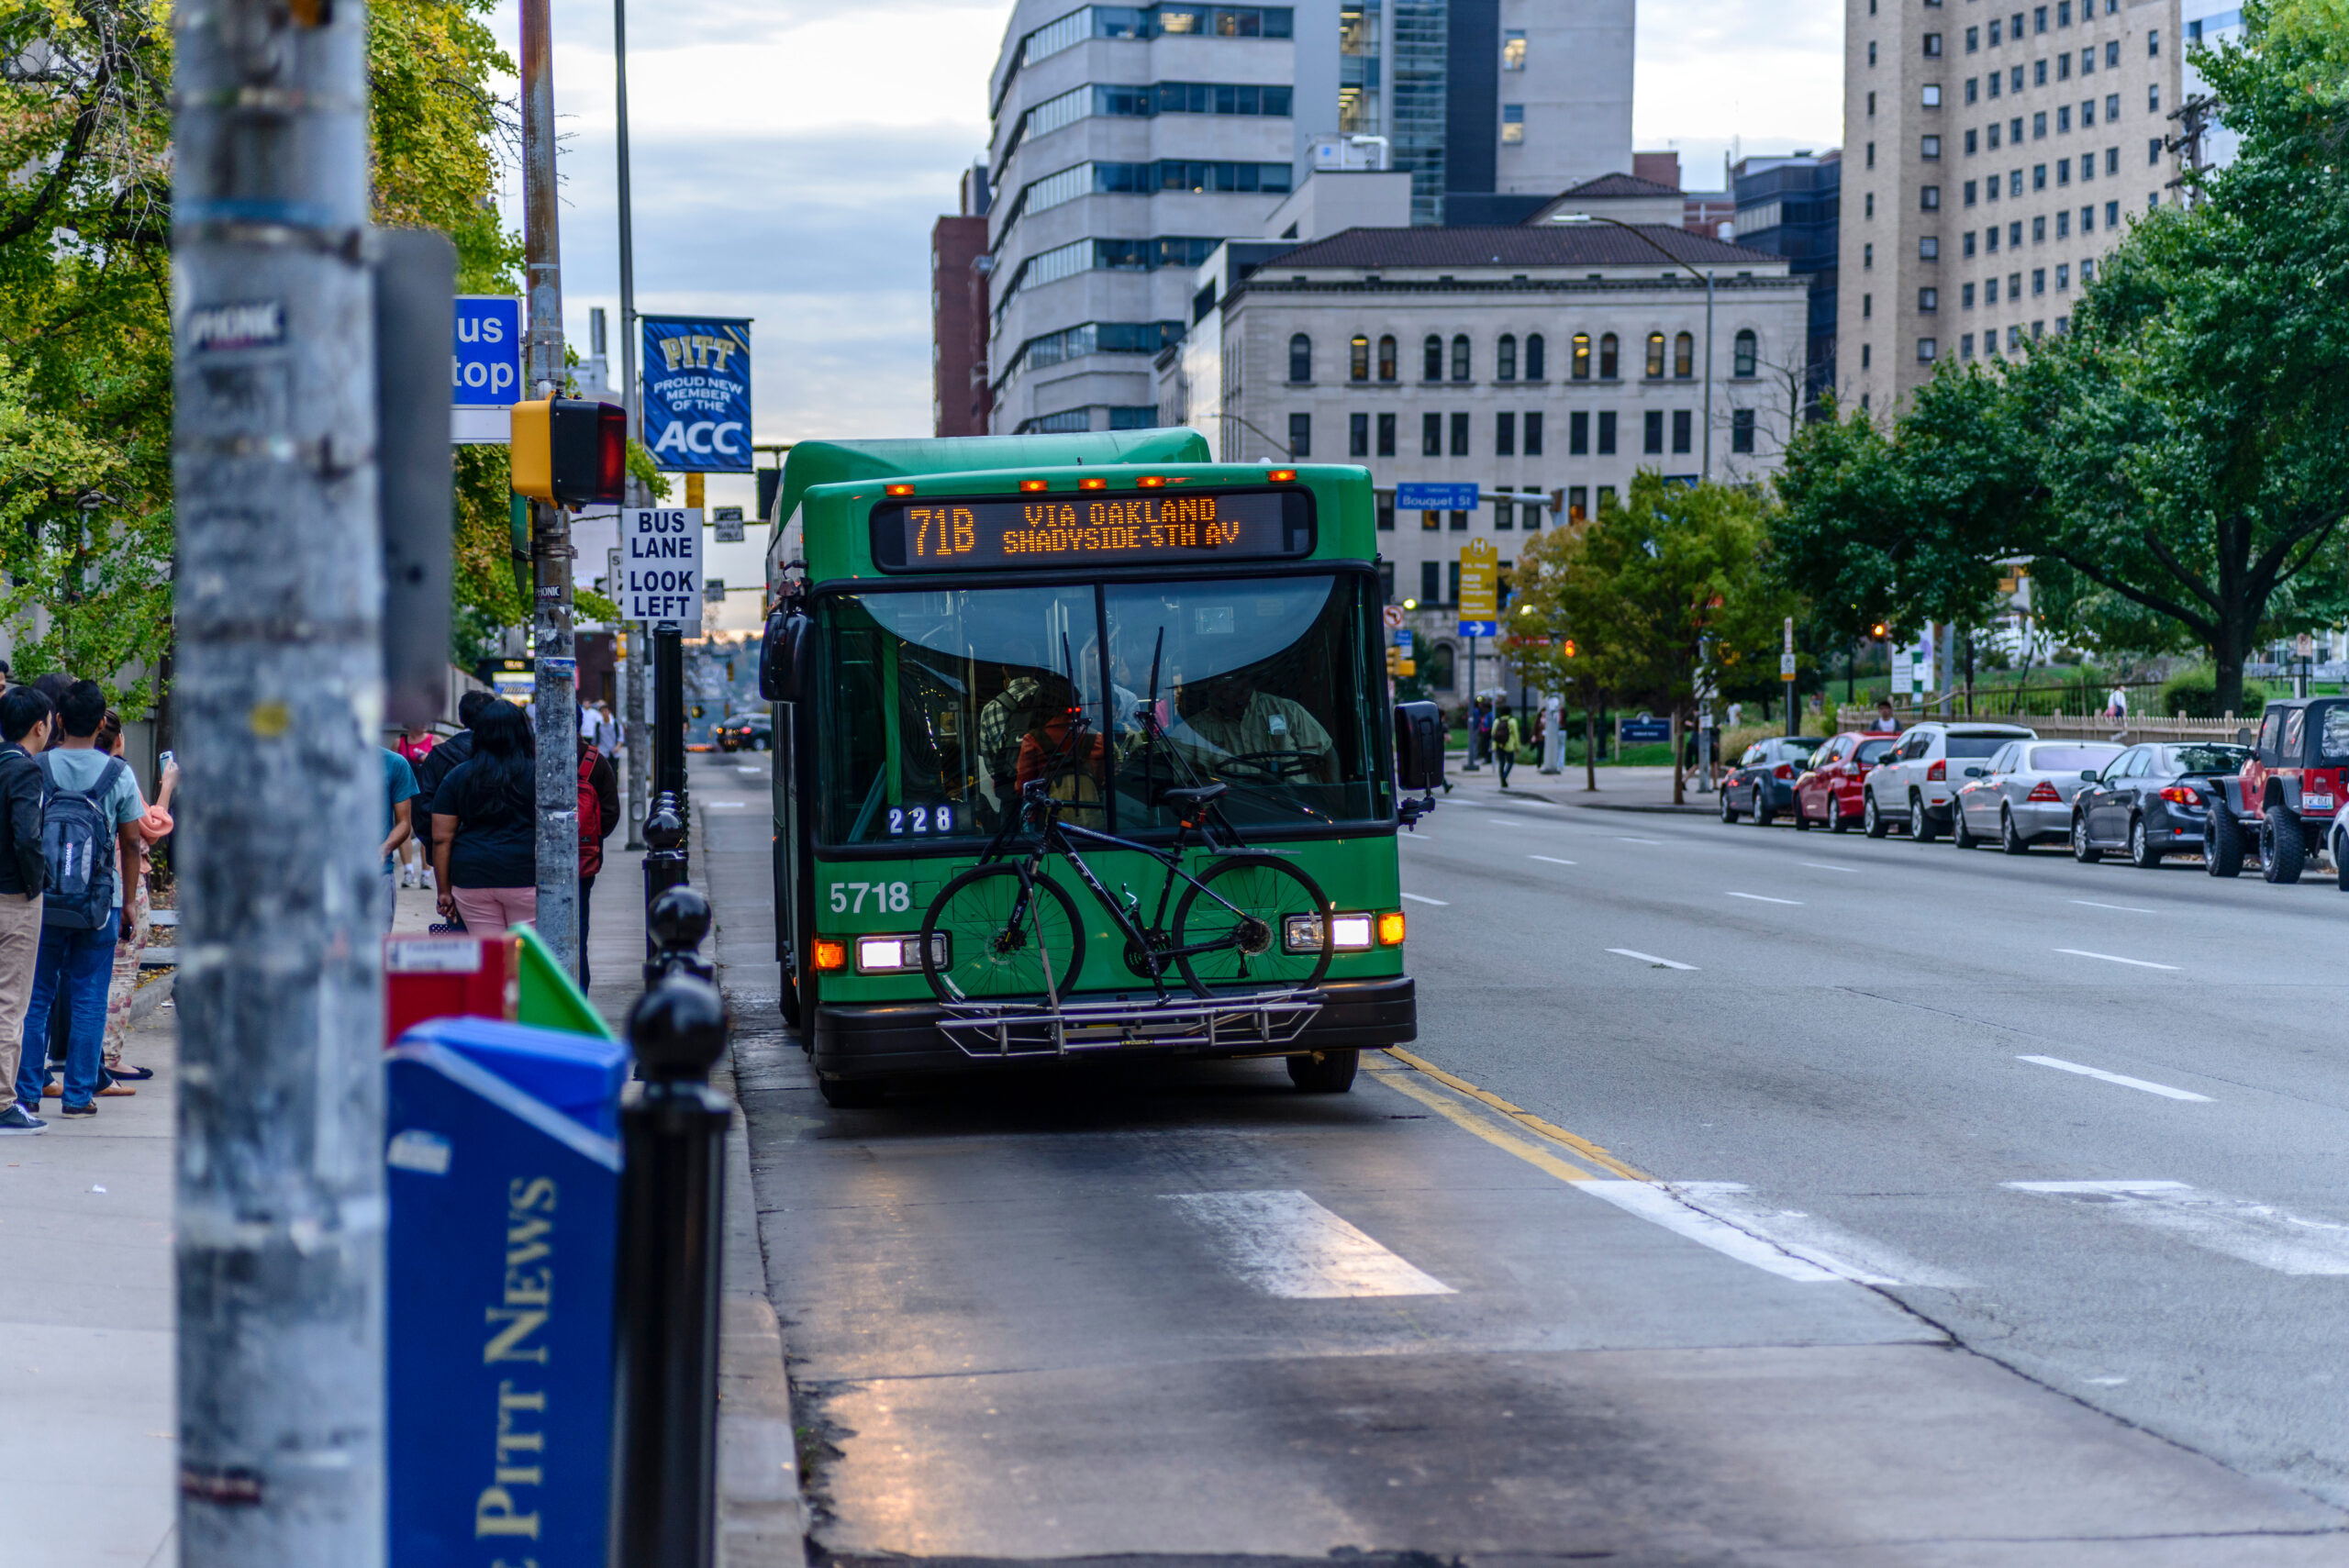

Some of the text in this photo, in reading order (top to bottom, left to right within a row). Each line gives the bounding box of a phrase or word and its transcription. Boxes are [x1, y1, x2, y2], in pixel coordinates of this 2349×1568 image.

[458, 317, 503, 343] us
[659, 335, 736, 373] PITT
[451, 355, 514, 394] top
[653, 376, 744, 395] PROUD NEW
[666, 388, 731, 404] MEMBER
[673, 399, 726, 413] OF THE
[653, 420, 743, 454] ACC
[1402, 495, 1471, 507] Bouquet St
[639, 512, 685, 533] BUS
[1025, 498, 1216, 528] VIA OAKLAND
[910, 508, 974, 556] 71B
[1003, 522, 1240, 553] SHADYSIDE-5TH AV
[631, 538, 692, 558] LANE
[630, 571, 694, 592] LOOK
[634, 596, 690, 617] LEFT
[830, 882, 910, 914] 5718
